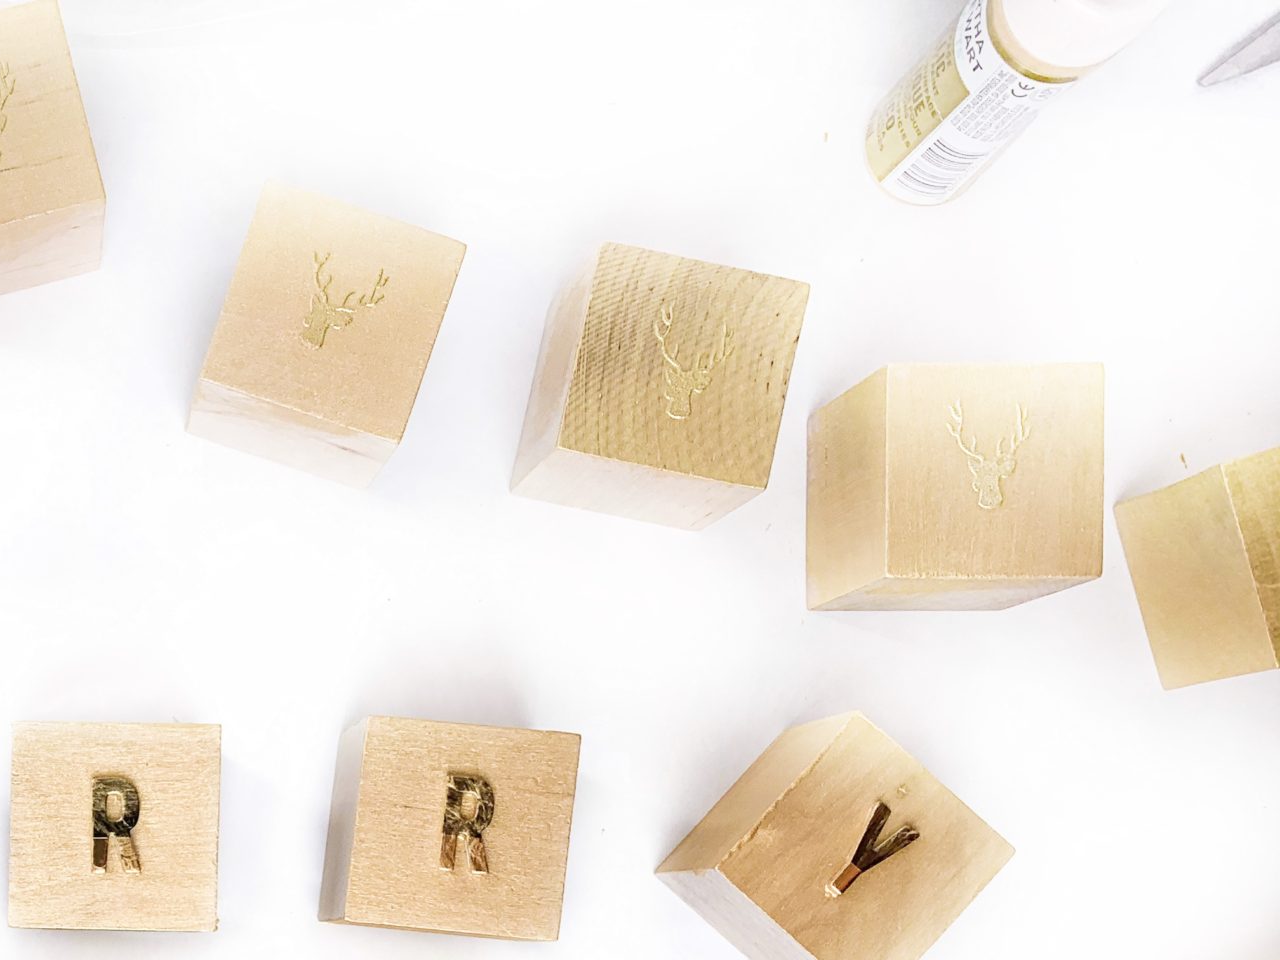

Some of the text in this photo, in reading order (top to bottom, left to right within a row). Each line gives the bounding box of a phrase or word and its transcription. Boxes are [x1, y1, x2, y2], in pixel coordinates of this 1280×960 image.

[91, 774, 140, 876] R
[440, 773, 495, 873] R
[823, 799, 920, 899] Y
